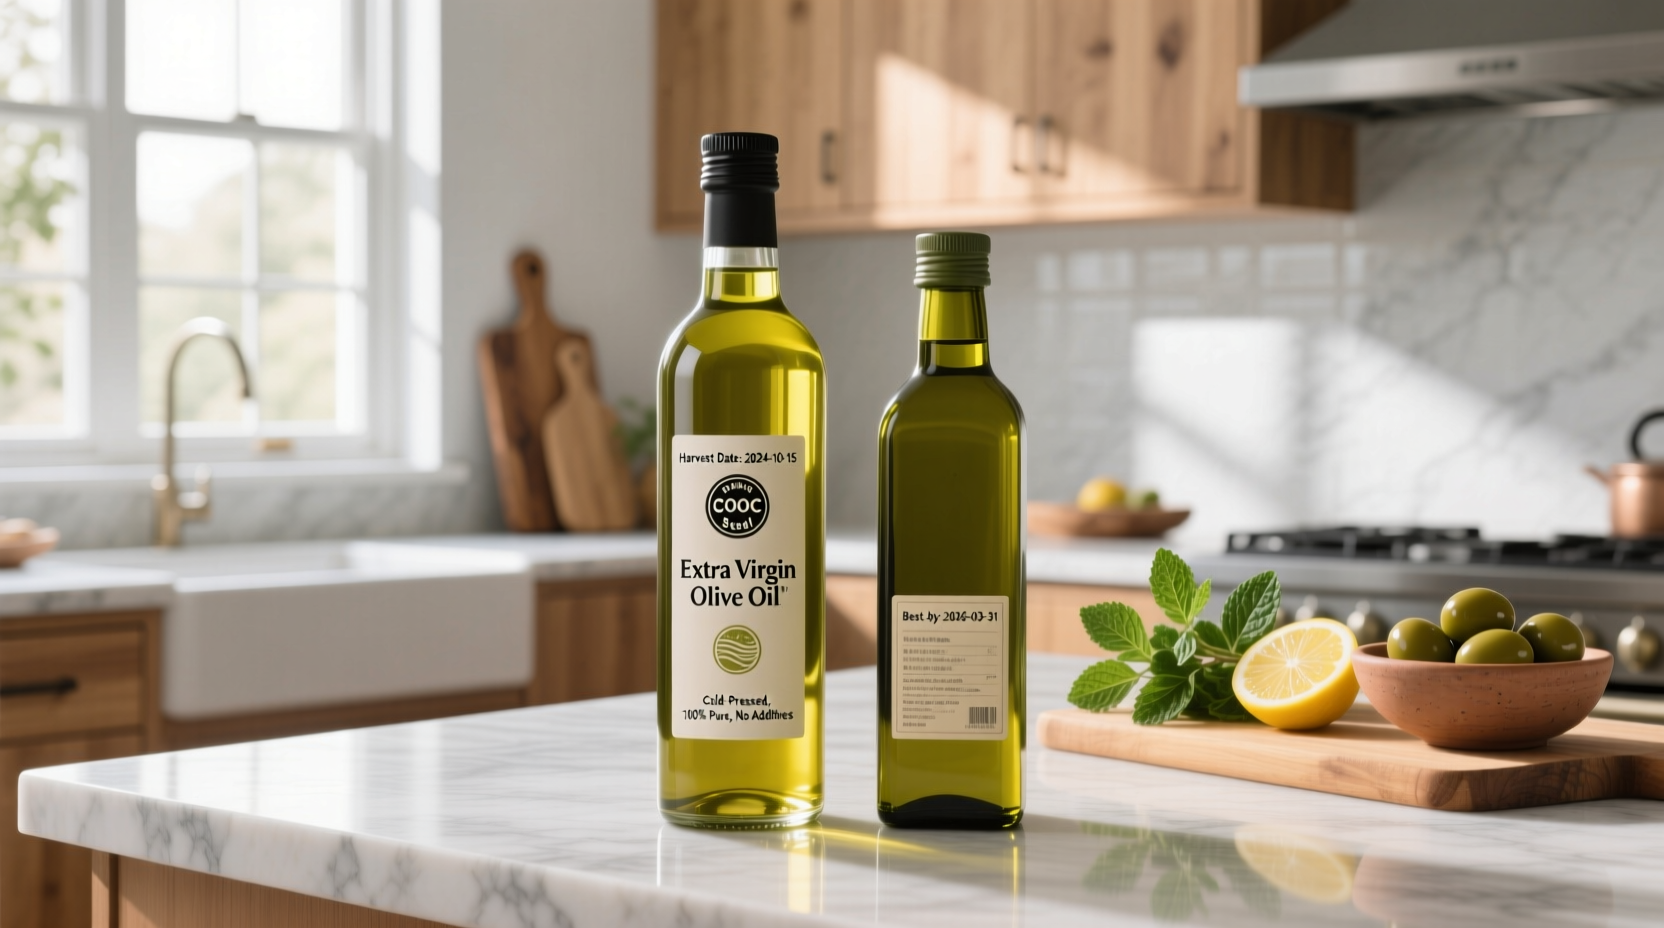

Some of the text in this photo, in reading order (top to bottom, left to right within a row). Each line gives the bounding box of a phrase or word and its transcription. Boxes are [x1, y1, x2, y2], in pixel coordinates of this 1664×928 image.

[679, 452, 714, 463] Harvest
[717, 452, 742, 463] Date:
[713, 498, 762, 513] COOC
[680, 559, 796, 585] Extra Virgin
[690, 585, 743, 606] Olive
[902, 611, 924, 622] Best
[927, 611, 941, 624] by
[682, 709, 706, 721] 100%
[736, 710, 749, 721] No
